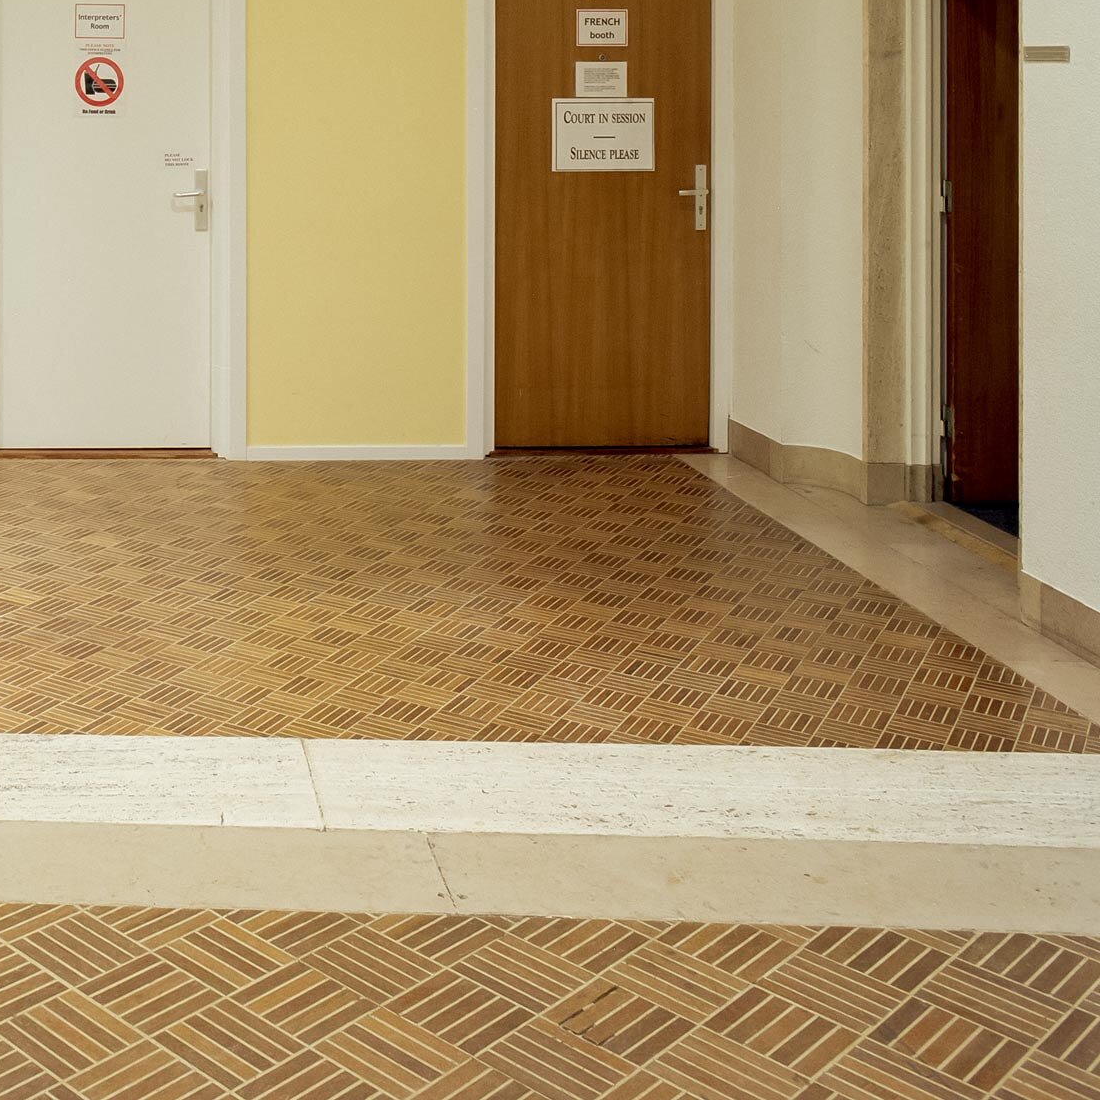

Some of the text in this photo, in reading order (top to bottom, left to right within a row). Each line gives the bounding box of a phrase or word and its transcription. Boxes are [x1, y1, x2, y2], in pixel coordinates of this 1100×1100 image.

[78, 13, 122, 22] Interpreters'
[584, 17, 621, 26] FRENCH
[90, 22, 110, 30] Room
[589, 31, 615, 39] booth
[563, 110, 646, 124] COURT IN SESSION
[570, 146, 640, 160] SILENCE PLEASE
